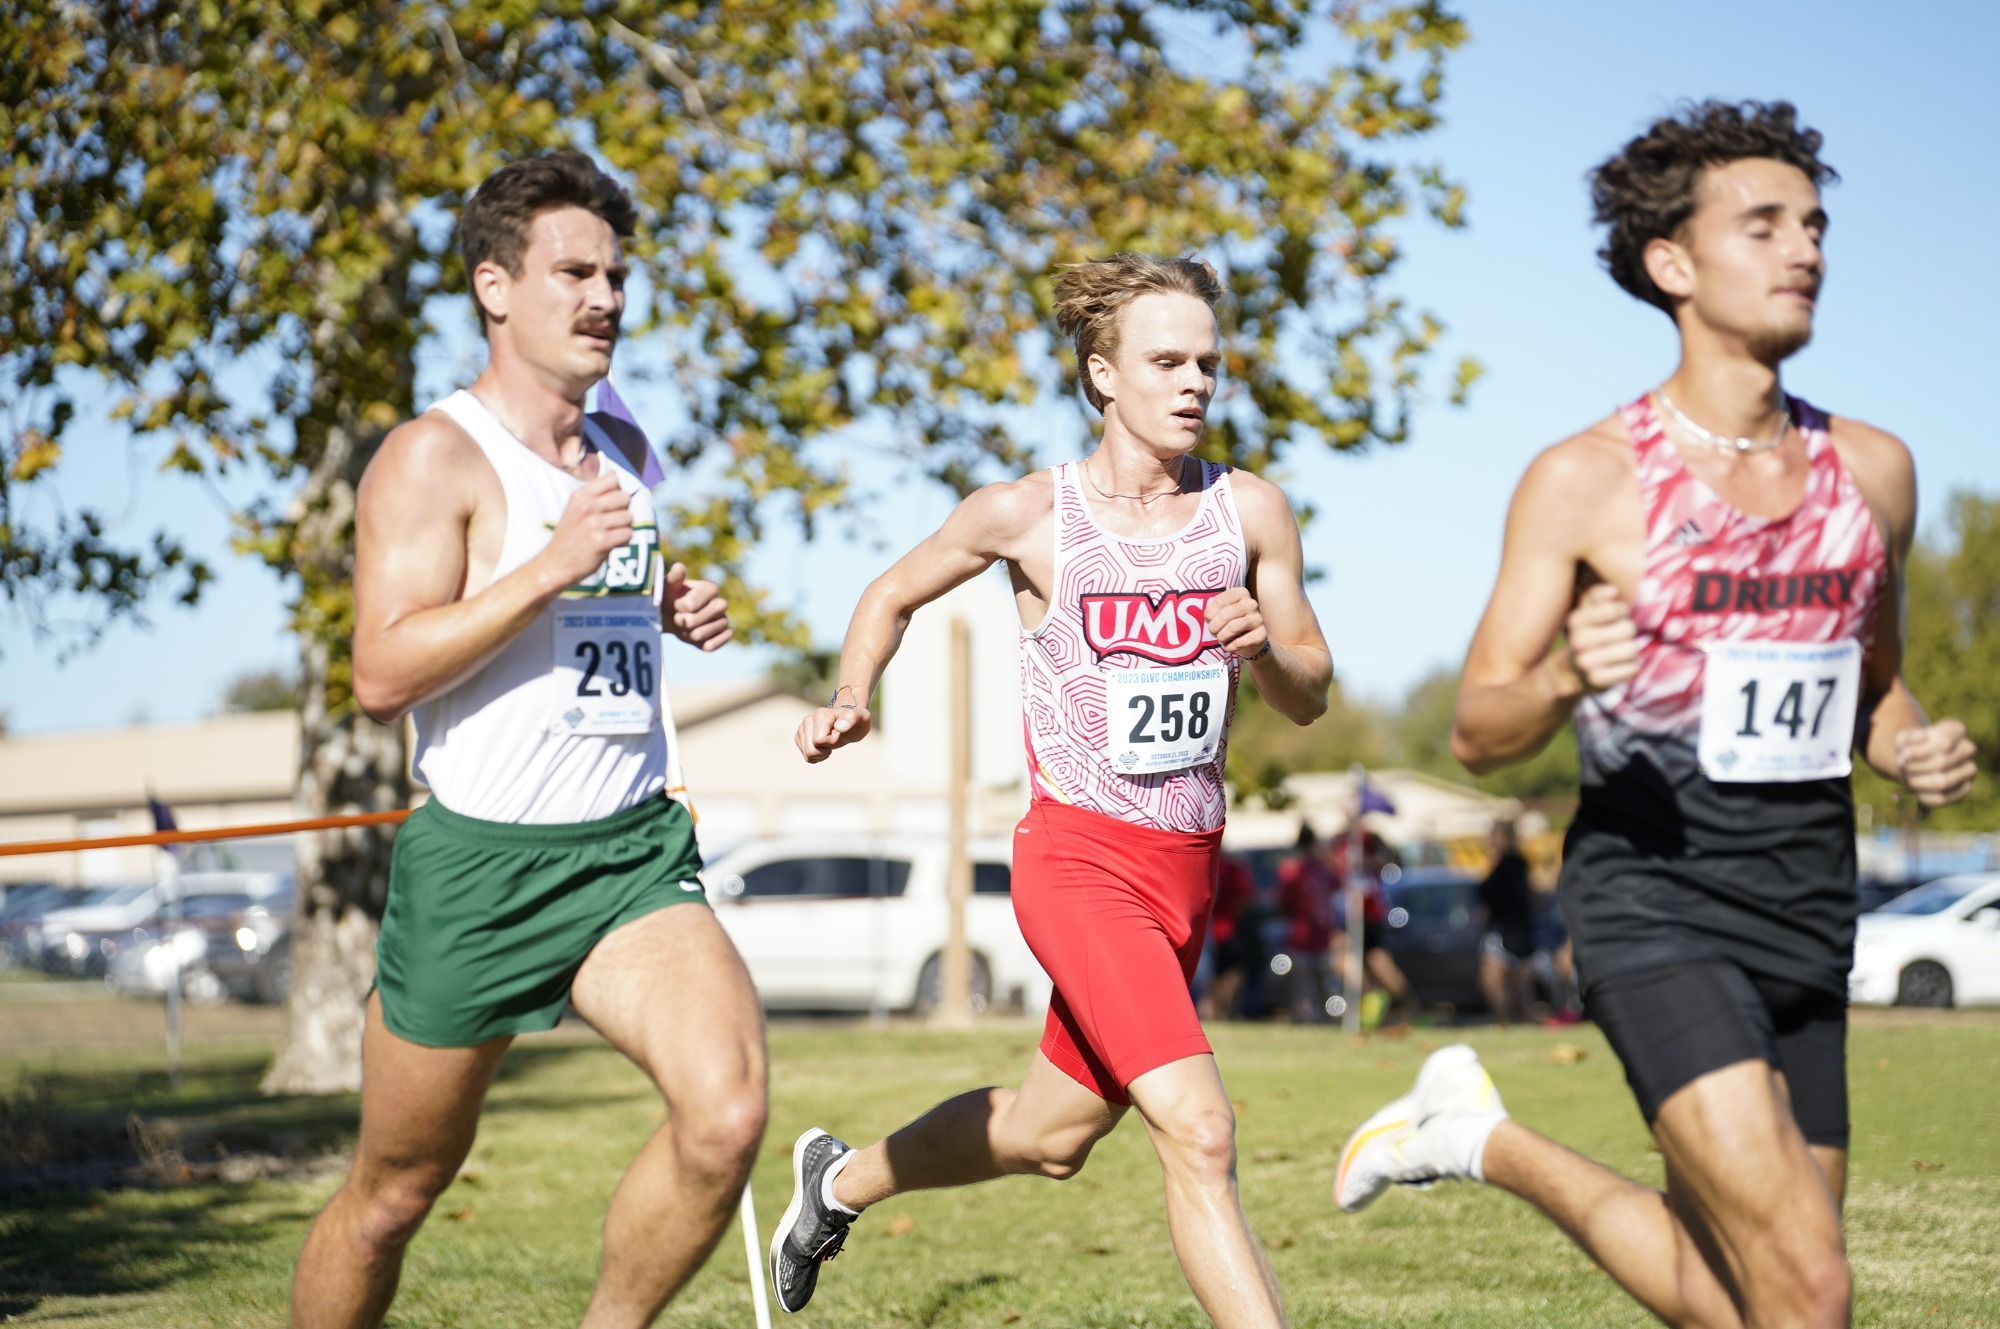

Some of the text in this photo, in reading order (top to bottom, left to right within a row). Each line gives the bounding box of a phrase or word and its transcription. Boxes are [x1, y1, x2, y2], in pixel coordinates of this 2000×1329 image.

[1693, 570, 1857, 613] DRURY
[575, 640, 653, 697] 236
[1117, 668, 1221, 684] 2023 GLVC CHAMPIONSHIPS
[1128, 691, 1210, 744] 258
[1736, 677, 1838, 739] 147
